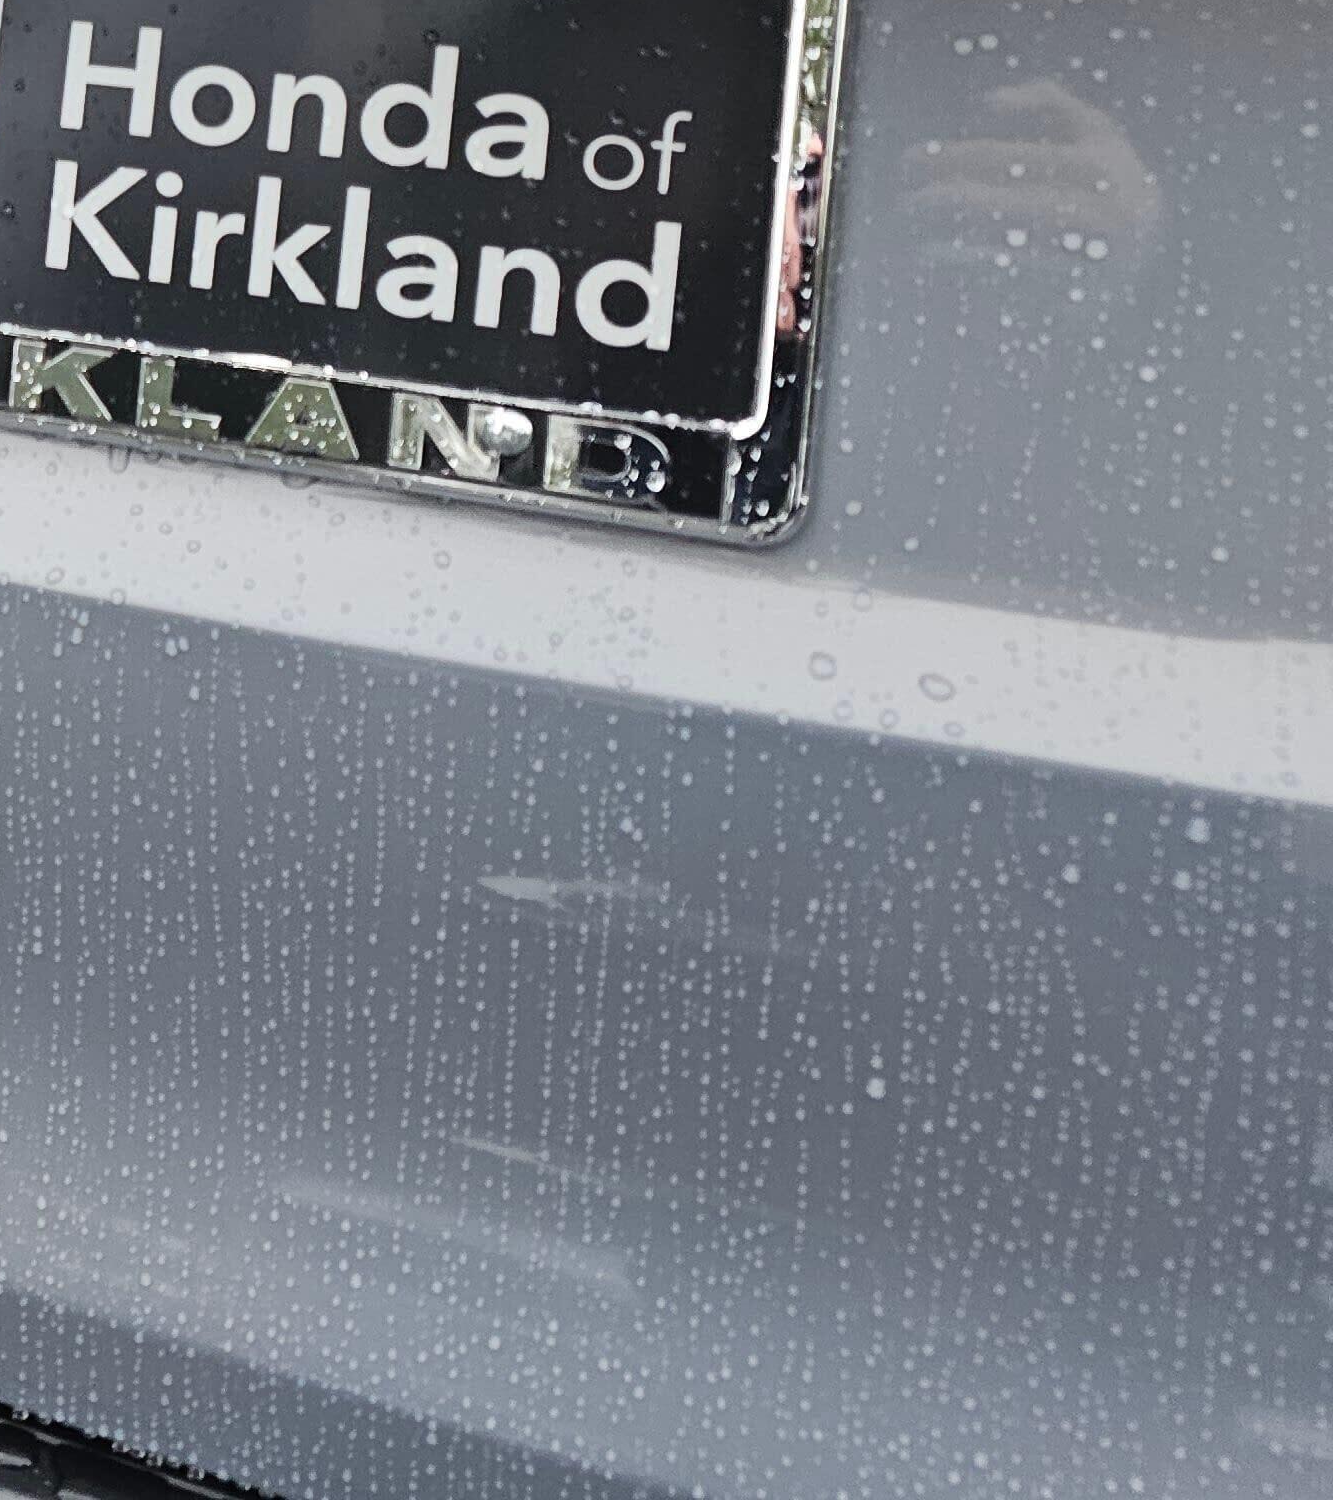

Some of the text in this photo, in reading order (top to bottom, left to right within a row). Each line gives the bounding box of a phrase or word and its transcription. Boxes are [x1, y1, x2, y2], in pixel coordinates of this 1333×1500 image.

[59, 20, 694, 195] Honda of
[44, 159, 683, 352] Kirkland
